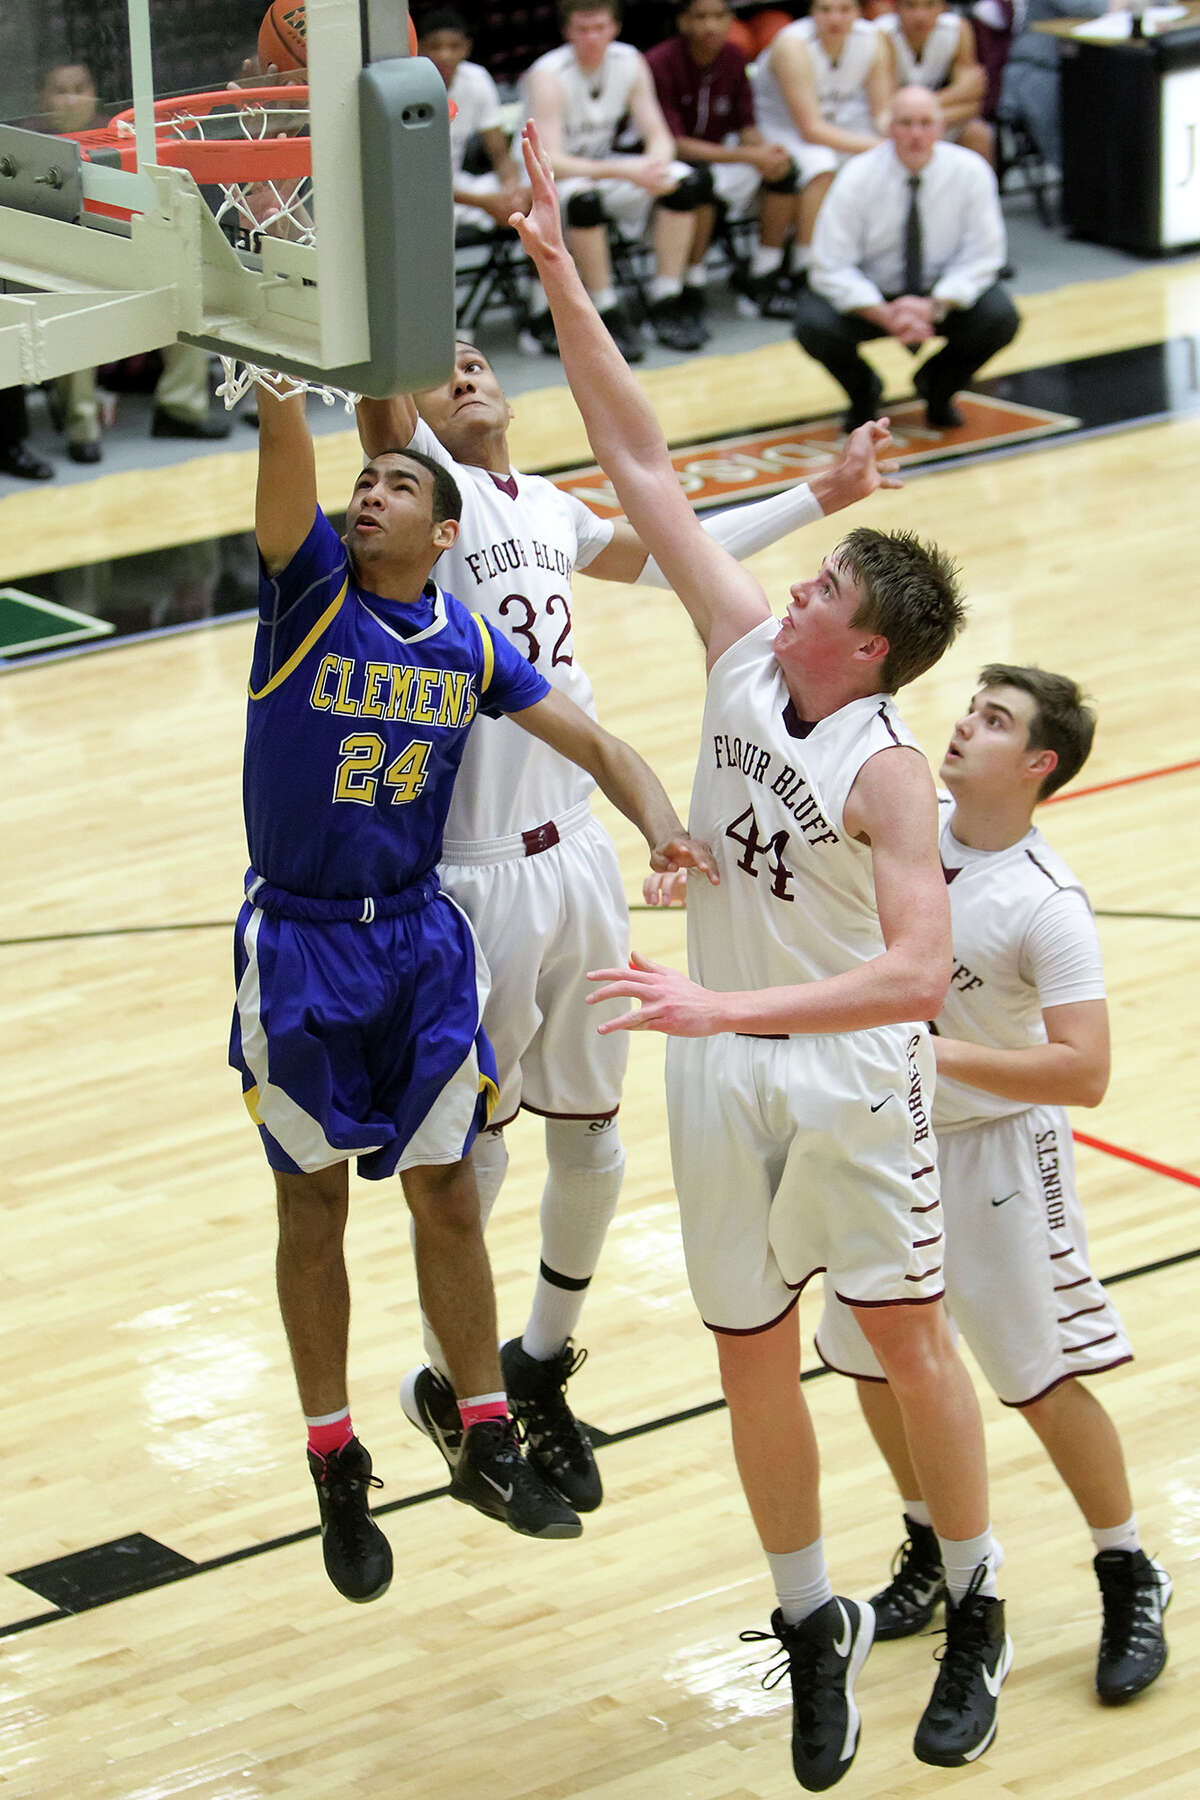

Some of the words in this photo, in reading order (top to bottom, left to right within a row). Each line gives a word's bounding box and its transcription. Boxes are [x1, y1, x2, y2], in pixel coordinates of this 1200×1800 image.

[498, 593, 573, 667] 32
[310, 653, 478, 728] CLEMENS
[332, 733, 433, 806] 24
[713, 735, 770, 784] FLOUR
[770, 764, 839, 849] BLUFF
[725, 802, 795, 902] 44
[1035, 1129, 1065, 1231] HORNETS
